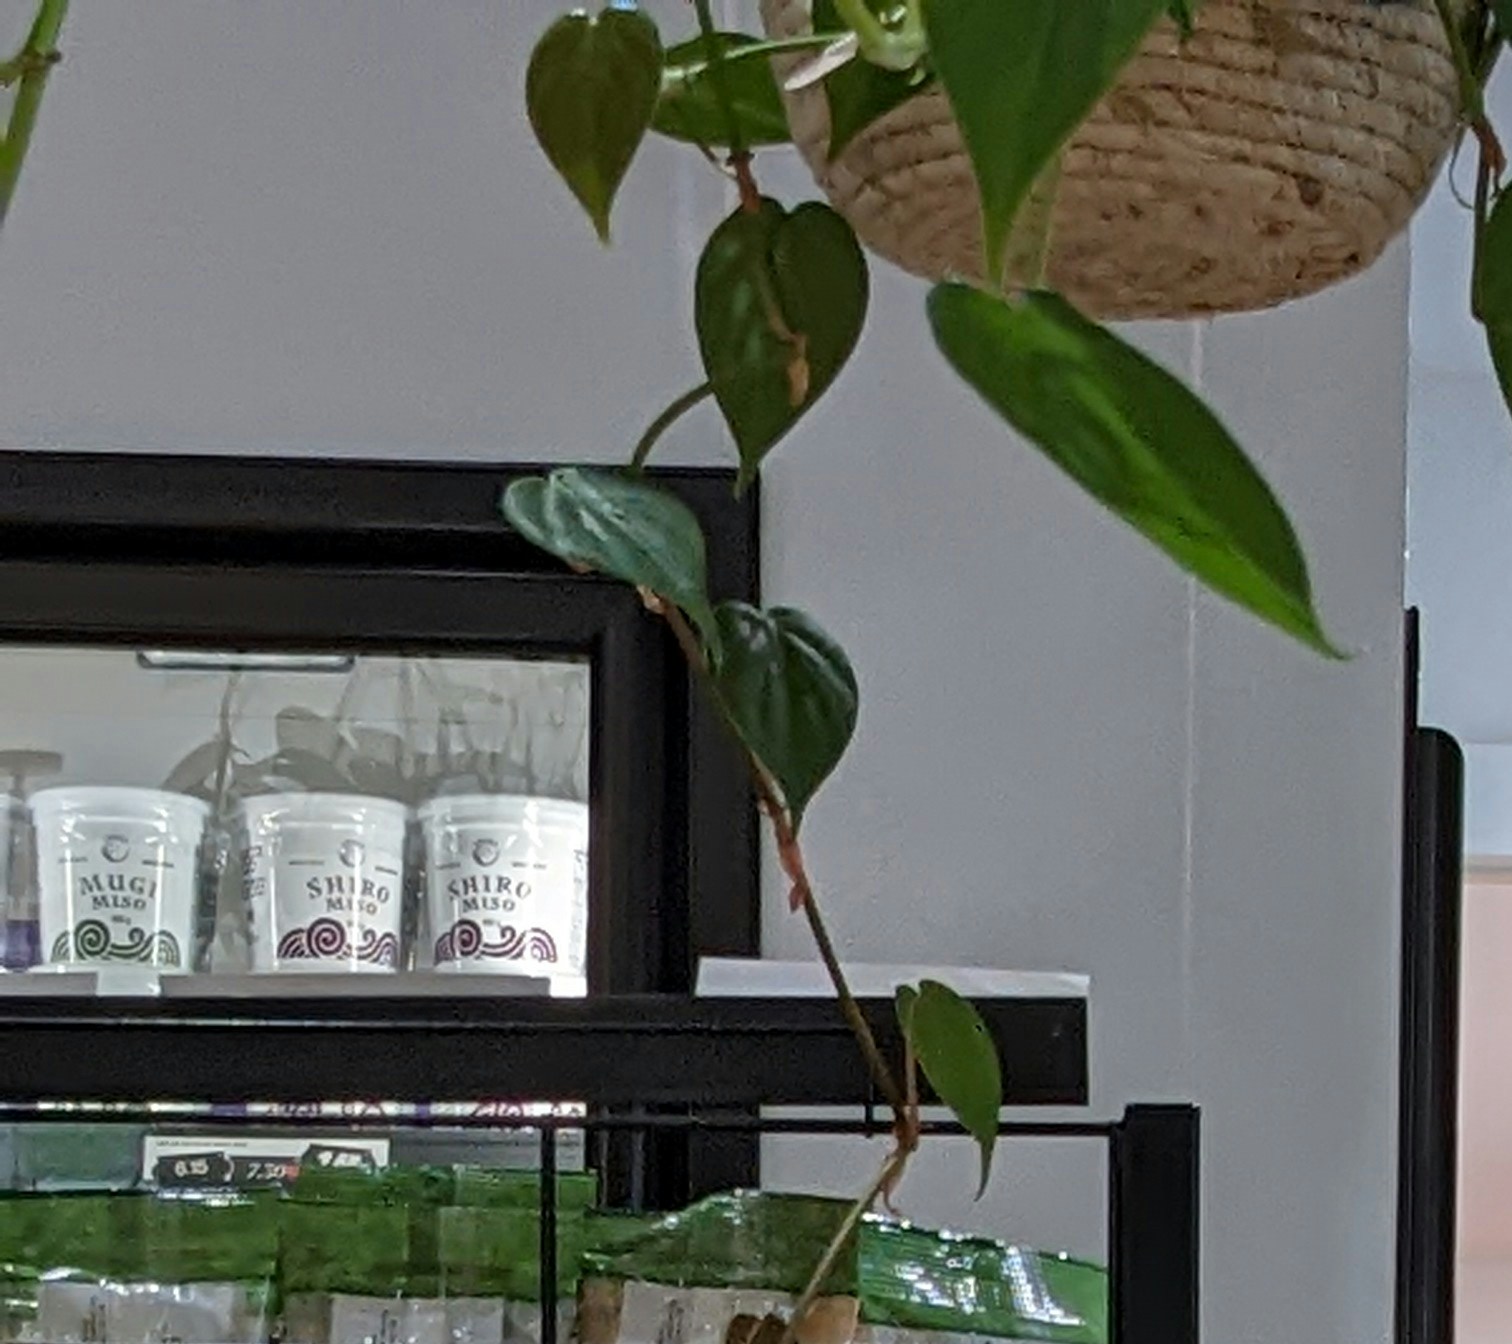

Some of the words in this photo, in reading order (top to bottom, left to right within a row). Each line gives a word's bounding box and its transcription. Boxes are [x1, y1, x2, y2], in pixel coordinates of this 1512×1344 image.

[305, 874, 390, 904] SHIRO
[447, 874, 532, 901] SHIRO
[91, 894, 148, 911] MISO
[462, 896, 516, 912] MISO
